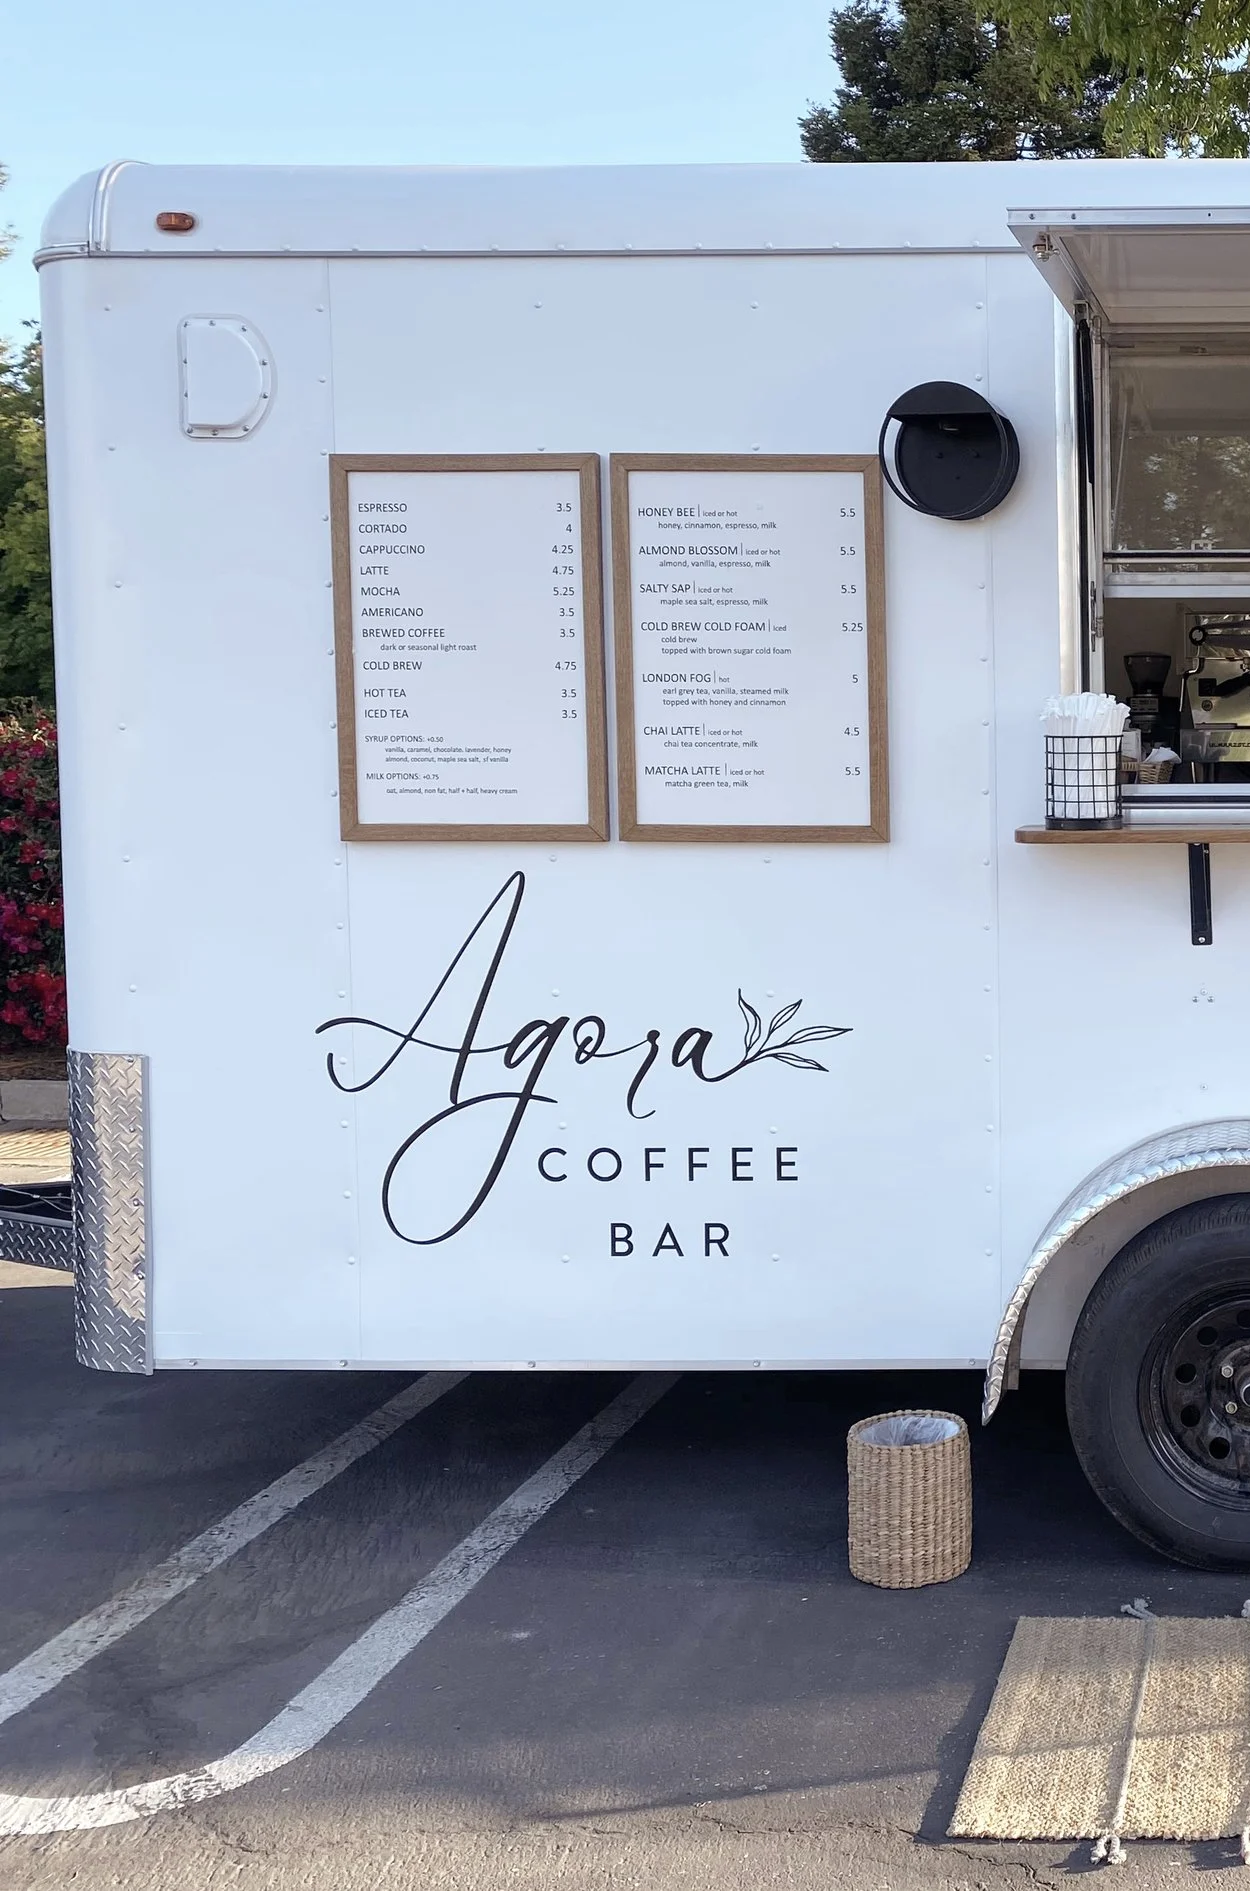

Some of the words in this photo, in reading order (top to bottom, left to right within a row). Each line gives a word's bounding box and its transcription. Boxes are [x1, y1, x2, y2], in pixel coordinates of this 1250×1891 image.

[358, 503, 407, 512] ESPRESSO
[557, 503, 571, 512] 3.5
[638, 508, 673, 516] HONEY
[677, 508, 695, 516] BEE
[841, 508, 855, 517] 5.5
[359, 524, 407, 533] CORTADO
[566, 524, 572, 533] 4
[658, 521, 683, 530] honey,
[684, 521, 723, 530] cinnamon,
[725, 523, 759, 531] espresso,
[359, 545, 425, 554] CAPPUCCINO
[552, 545, 573, 554] 4.25
[639, 546, 685, 555] ALMOND
[689, 546, 737, 555] BLOSSOM
[841, 547, 855, 555] 5.5
[659, 560, 689, 568] almond,
[691, 560, 717, 568] vanilla,
[360, 566, 388, 575] LATTE
[553, 566, 574, 575] 4.75
[361, 587, 400, 596] MOCHA
[553, 587, 574, 596] 5.25
[640, 584, 669, 593] SALTY
[672, 584, 690, 593] SAP
[841, 585, 856, 593] 5.5
[661, 598, 684, 607] maple
[699, 598, 715, 607] salt,
[716, 600, 750, 608] espresso,
[361, 608, 423, 617] AMERICANO
[560, 608, 574, 617] 3.5
[641, 622, 668, 631] COLD
[671, 622, 701, 631] BREW
[704, 622, 731, 631] COLD
[735, 622, 765, 631] FOAM
[842, 623, 863, 631] 5.25
[362, 628, 405, 637] BREWED
[408, 628, 445, 637] COFFEE
[560, 628, 575, 637] 3.5
[380, 643, 396, 651] dark
[408, 643, 438, 651] seasonal
[440, 643, 457, 652] light
[662, 646, 688, 655] topped
[363, 661, 390, 670] COLD
[393, 661, 422, 670] BREW
[555, 661, 576, 670] 4.75
[643, 674, 686, 682] LONDON
[690, 674, 711, 682] FOG
[853, 674, 858, 683] 5
[364, 689, 385, 697] HOT
[387, 689, 406, 698] TEA
[562, 689, 576, 698] 3.5
[696, 688, 710, 697] tea,
[663, 698, 689, 707] topped
[709, 698, 732, 707] honey
[365, 709, 387, 718] ICED
[389, 709, 408, 718] TEA
[562, 710, 577, 718] 3.5
[644, 727, 668, 735] CHAI
[671, 727, 700, 735] LATTE
[844, 727, 859, 736] 4.5
[694, 740, 740, 748] concentrate,
[645, 766, 688, 775] MATCHA
[691, 766, 720, 775] LATTE
[846, 767, 860, 775] 5.5
[665, 779, 692, 787] matcha
[315, 871, 748, 1244] Agora
[538, 1147, 798, 1182] COFFEE
[611, 1223, 729, 1256] BAR
